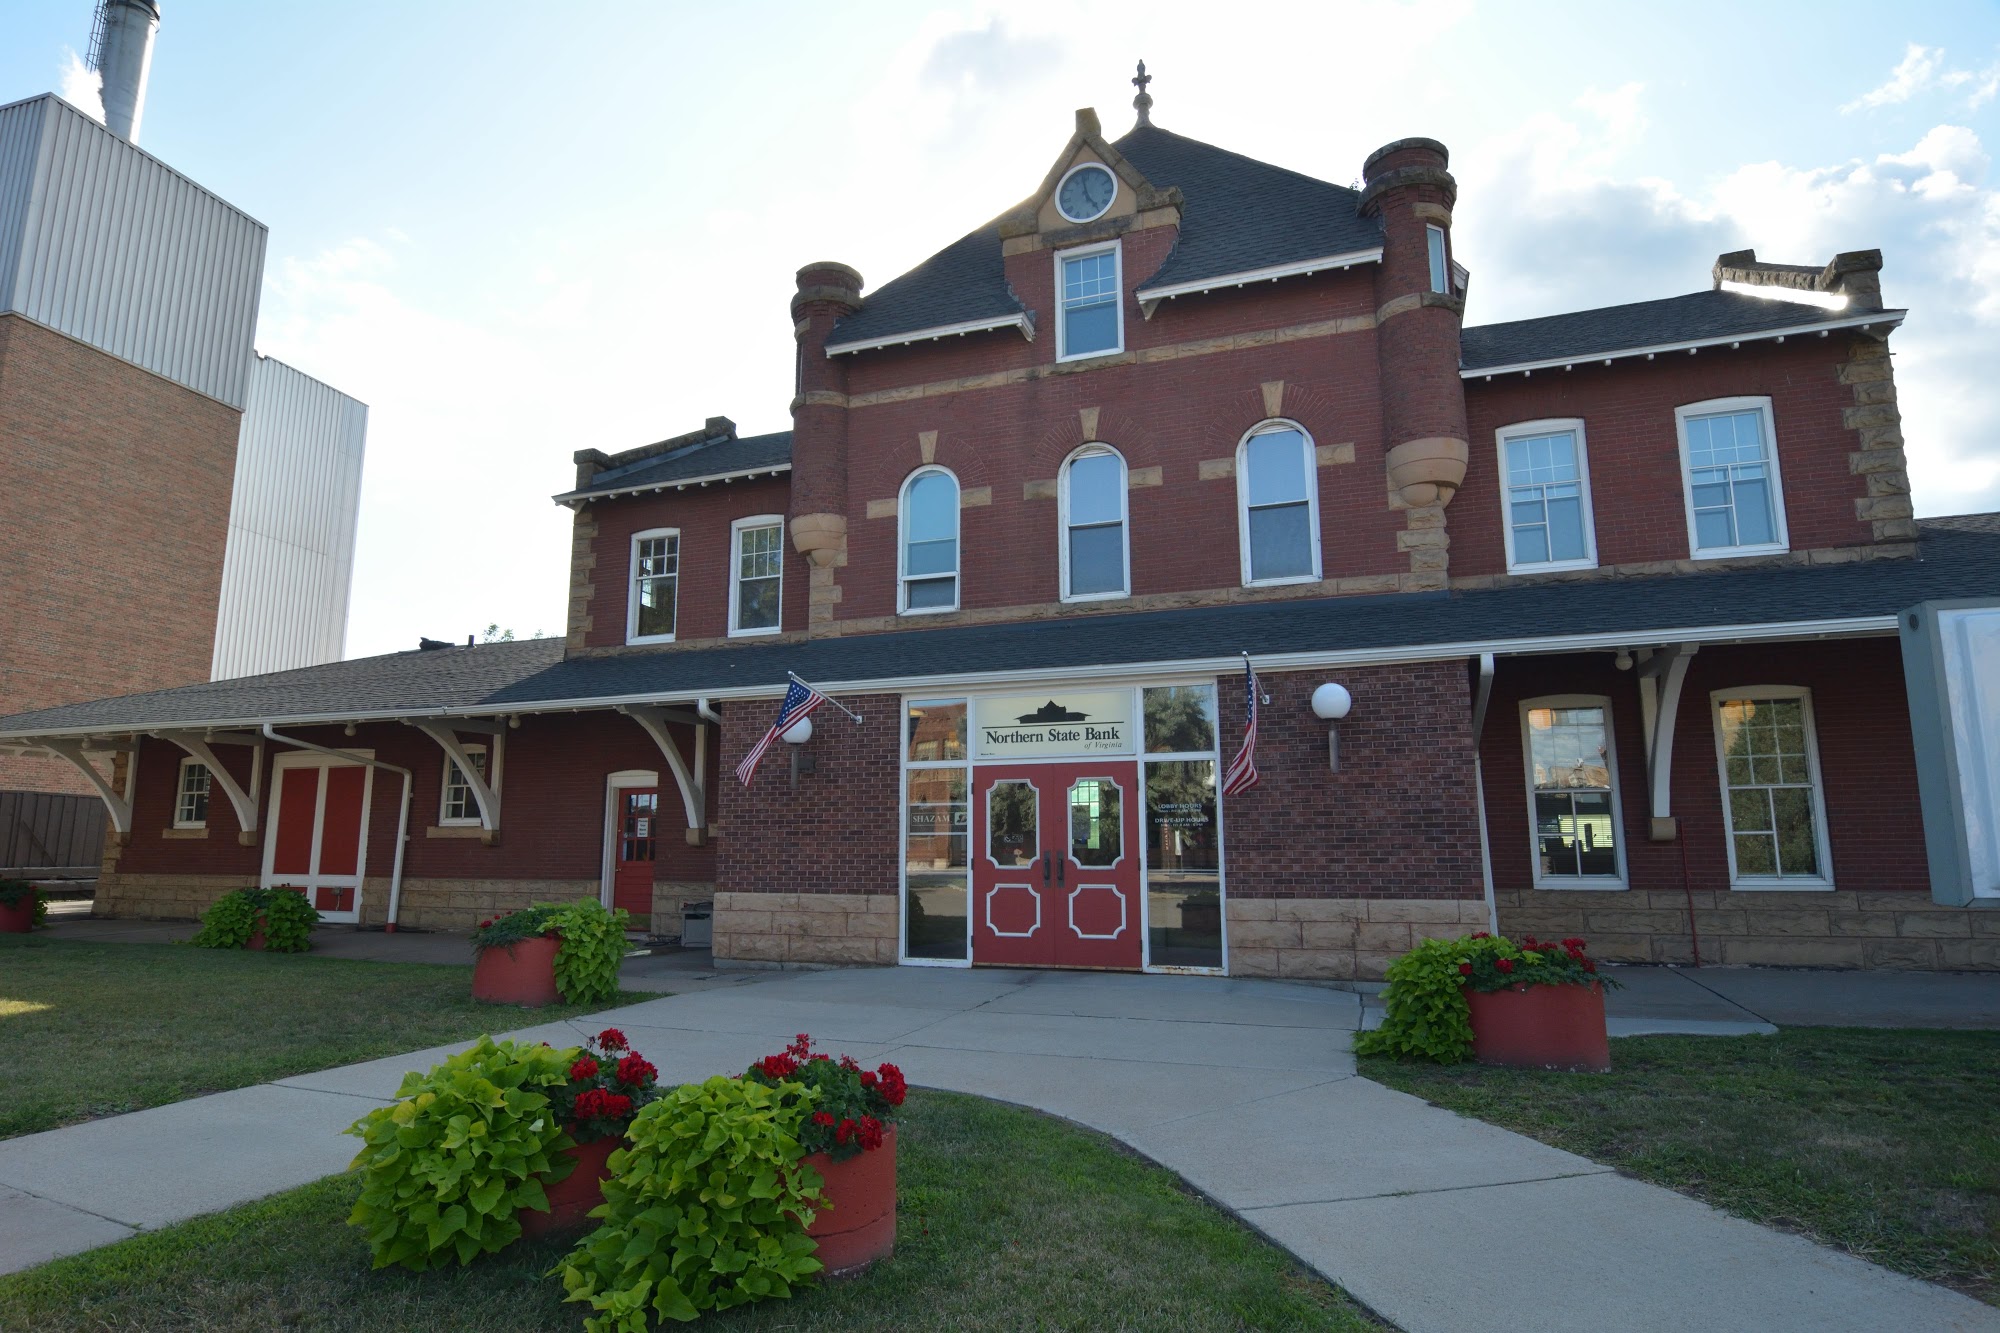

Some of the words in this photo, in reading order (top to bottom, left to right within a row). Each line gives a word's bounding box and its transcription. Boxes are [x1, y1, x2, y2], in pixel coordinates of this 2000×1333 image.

[985, 730, 1044, 744] Northern
[1048, 728, 1081, 742] State
[1085, 726, 1121, 741] Bank
[1084, 742, 1092, 750] of
[1095, 741, 1123, 749] Virginia
[912, 815, 950, 823] SHAZAM
